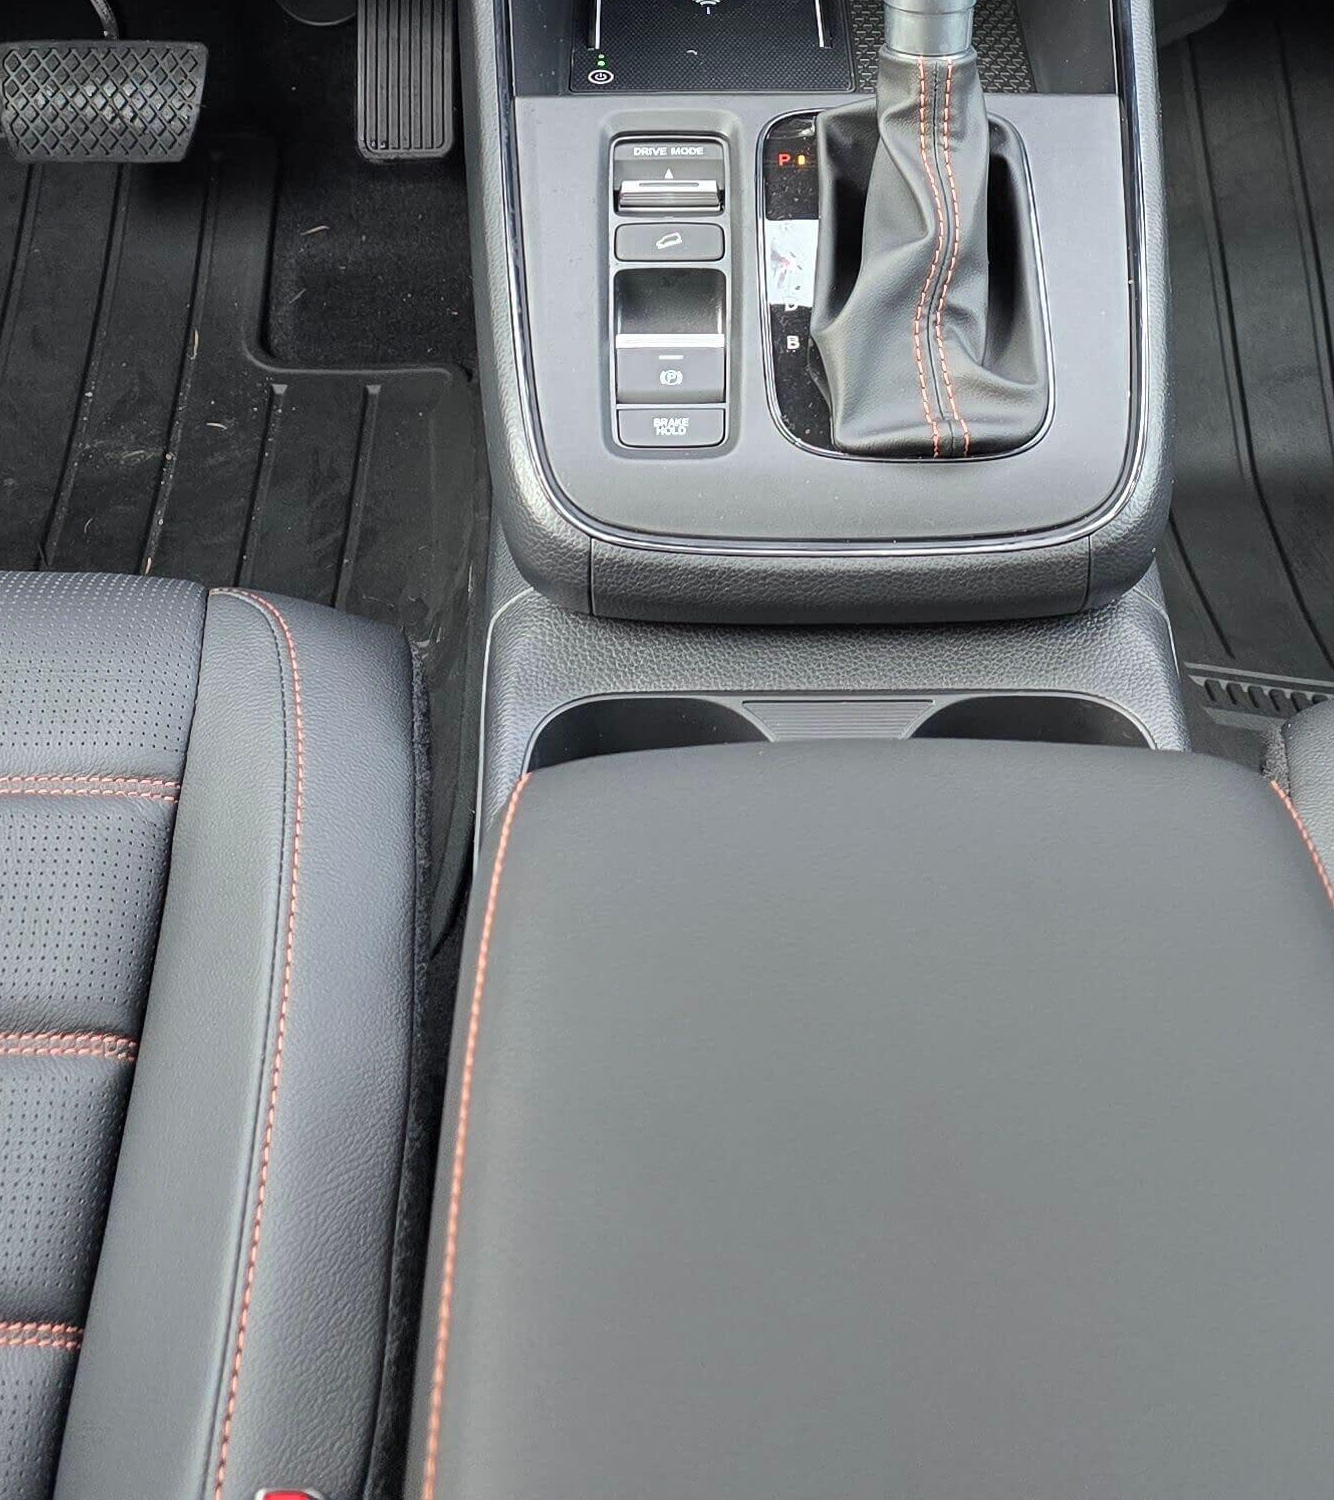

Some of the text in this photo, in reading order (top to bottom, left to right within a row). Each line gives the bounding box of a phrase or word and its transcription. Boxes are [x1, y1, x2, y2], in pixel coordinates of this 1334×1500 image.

[633, 147, 704, 156] DRIVE MODE
[778, 153, 791, 166] P
[786, 335, 800, 350] B
[653, 417, 689, 427] BRAKE
[656, 426, 687, 436] HOLD
